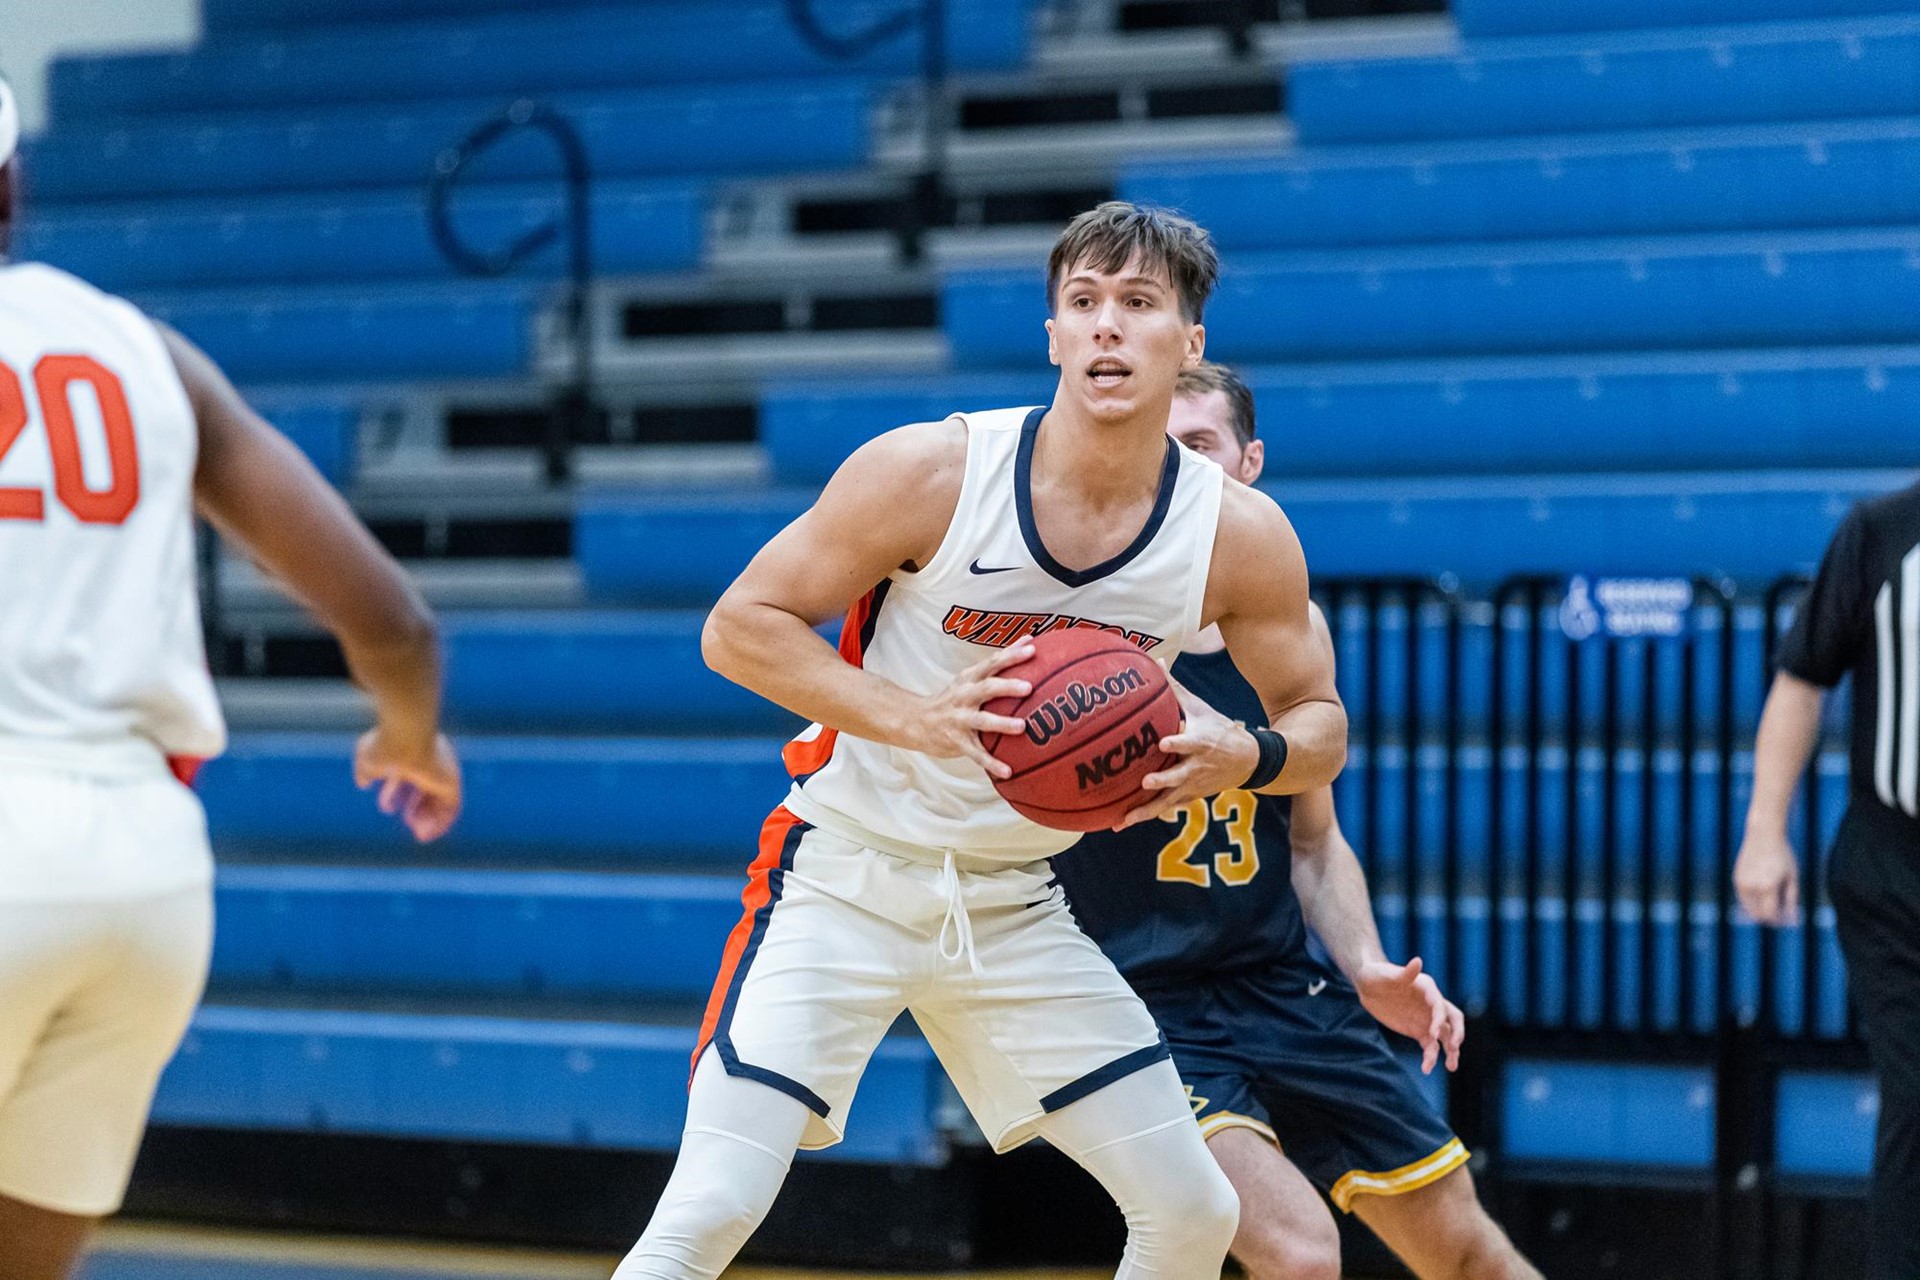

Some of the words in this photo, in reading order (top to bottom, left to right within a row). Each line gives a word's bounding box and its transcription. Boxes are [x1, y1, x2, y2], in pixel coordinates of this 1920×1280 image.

[0, 354, 140, 526] 20
[942, 604, 1164, 654] WHEN
[1024, 667, 1149, 747] Wilson
[1075, 720, 1160, 790] NCAA
[1156, 788, 1260, 888] 23
